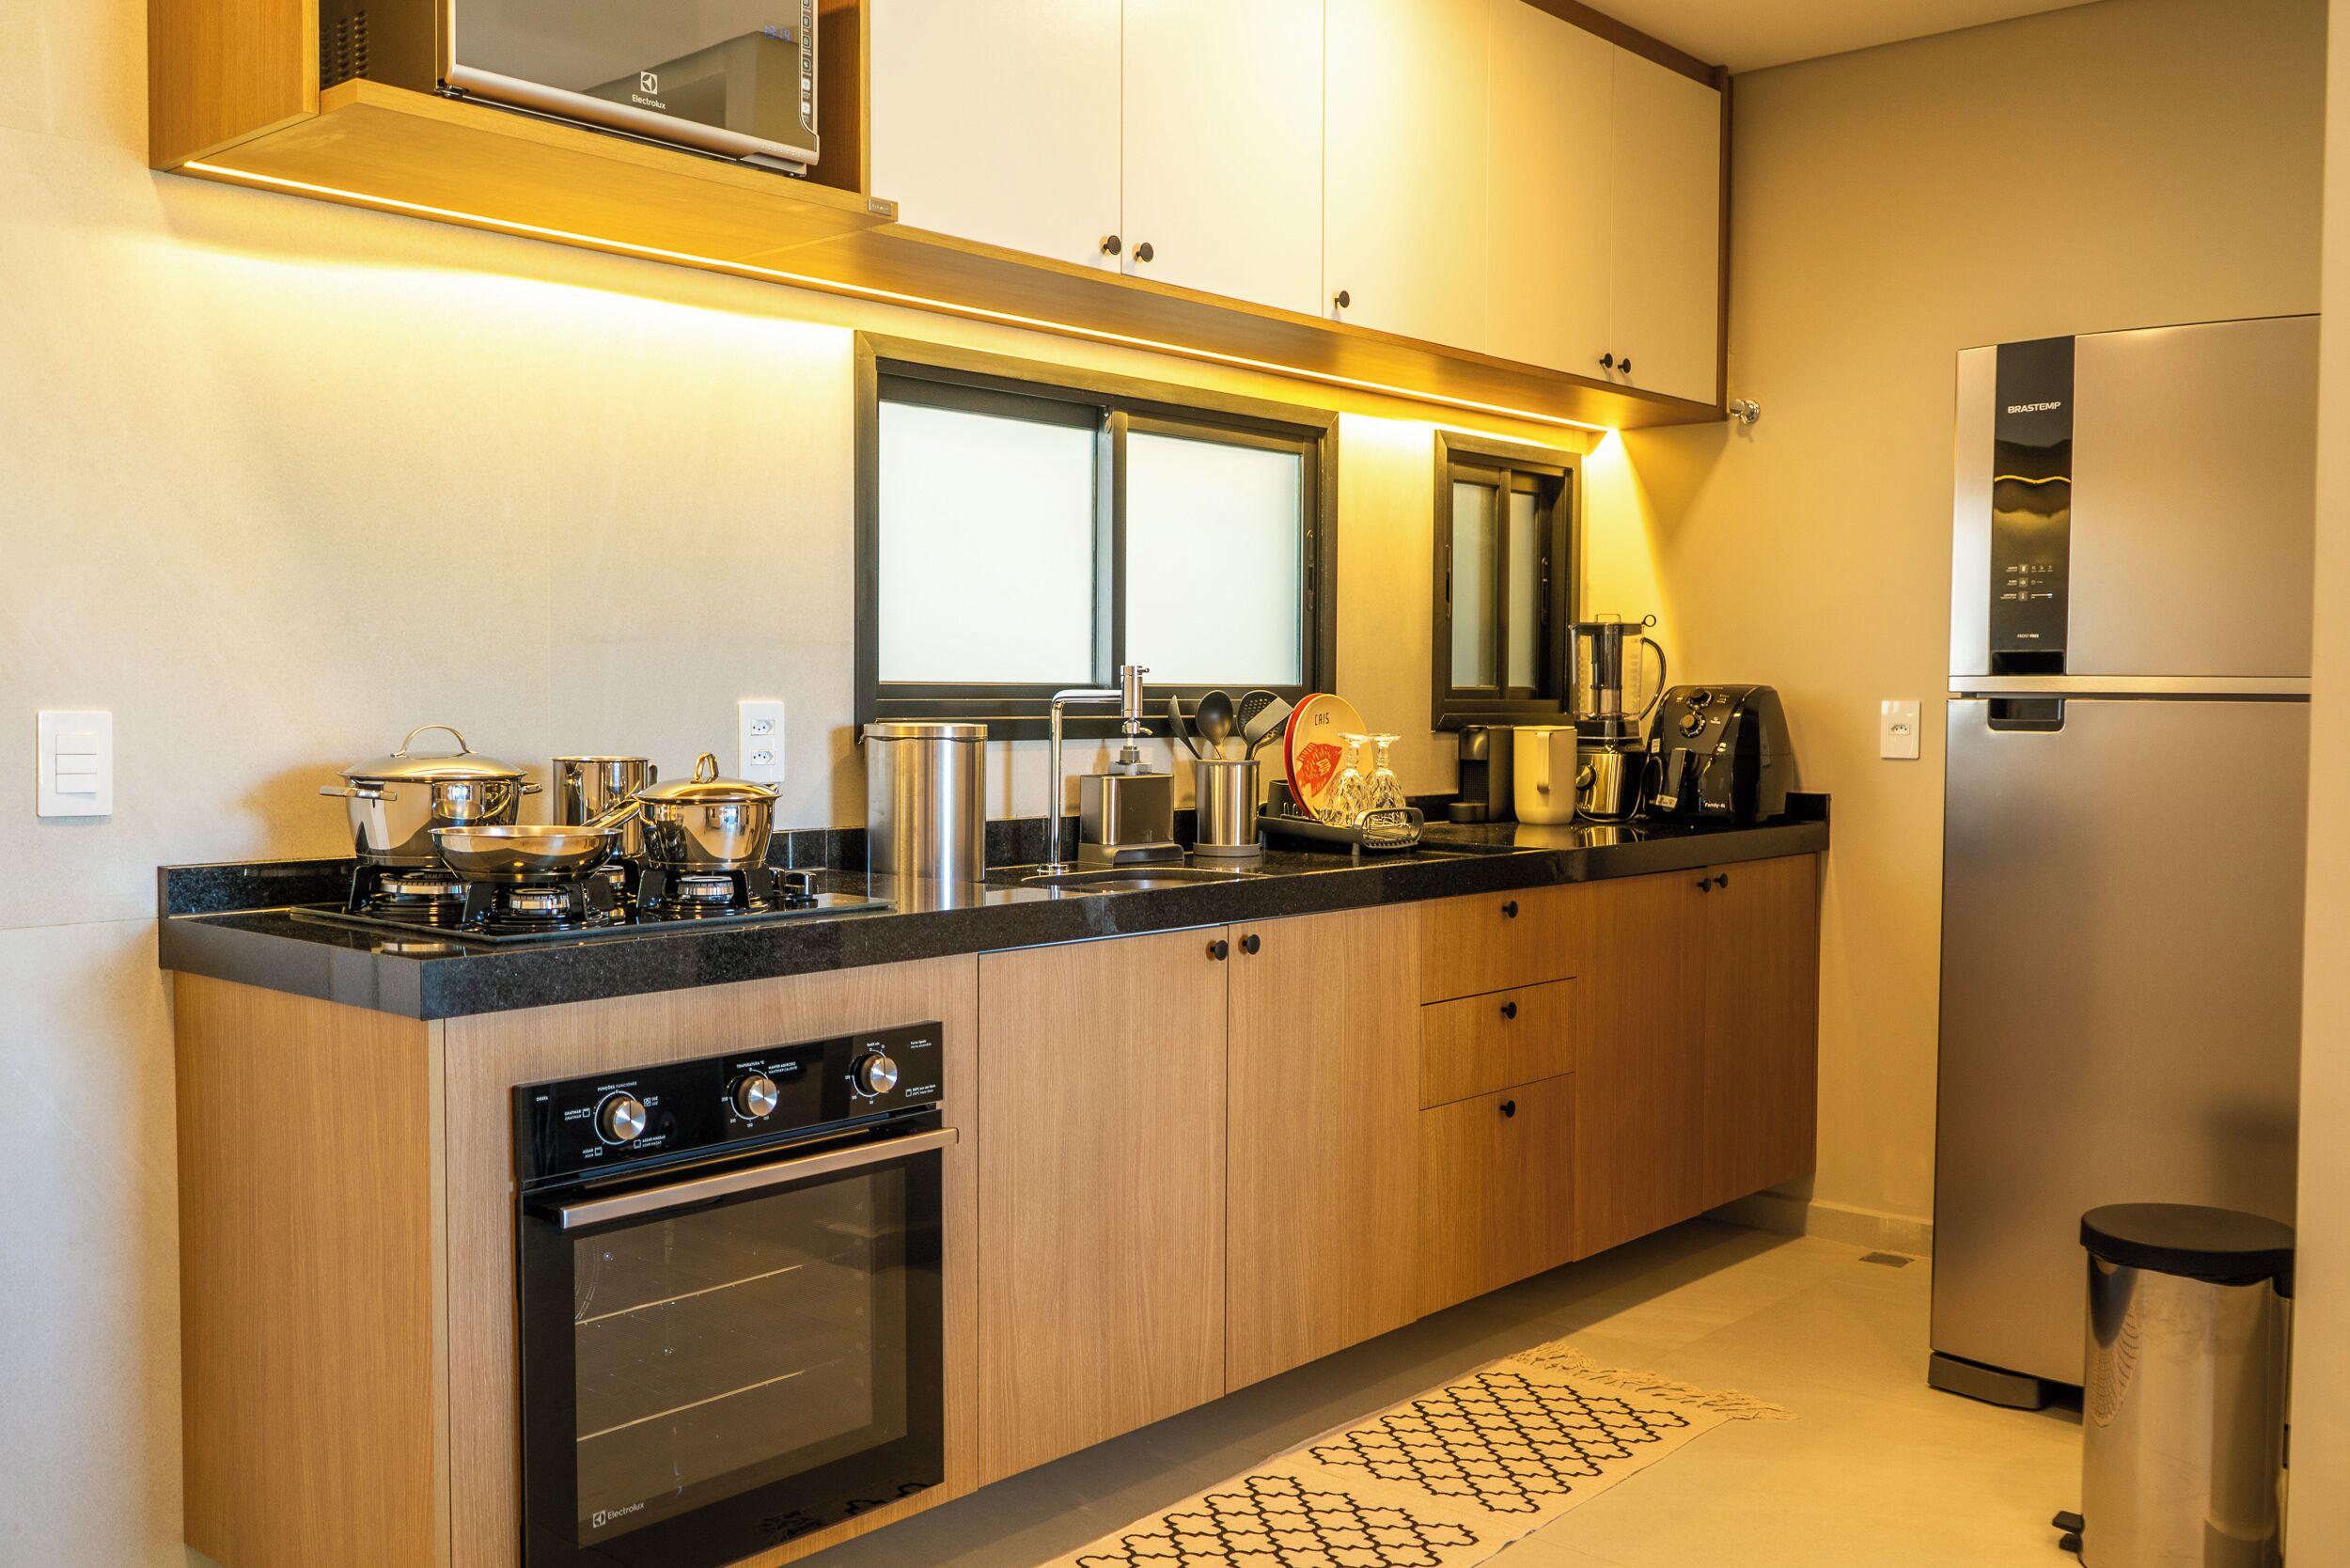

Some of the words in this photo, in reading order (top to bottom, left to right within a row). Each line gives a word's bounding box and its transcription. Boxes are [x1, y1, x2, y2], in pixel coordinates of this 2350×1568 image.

[632, 93, 666, 110] Electrolux
[2007, 401, 2061, 415] BRASTEMP
[1314, 713, 1330, 726] CAIS
[607, 1501, 645, 1520] Electrolux
